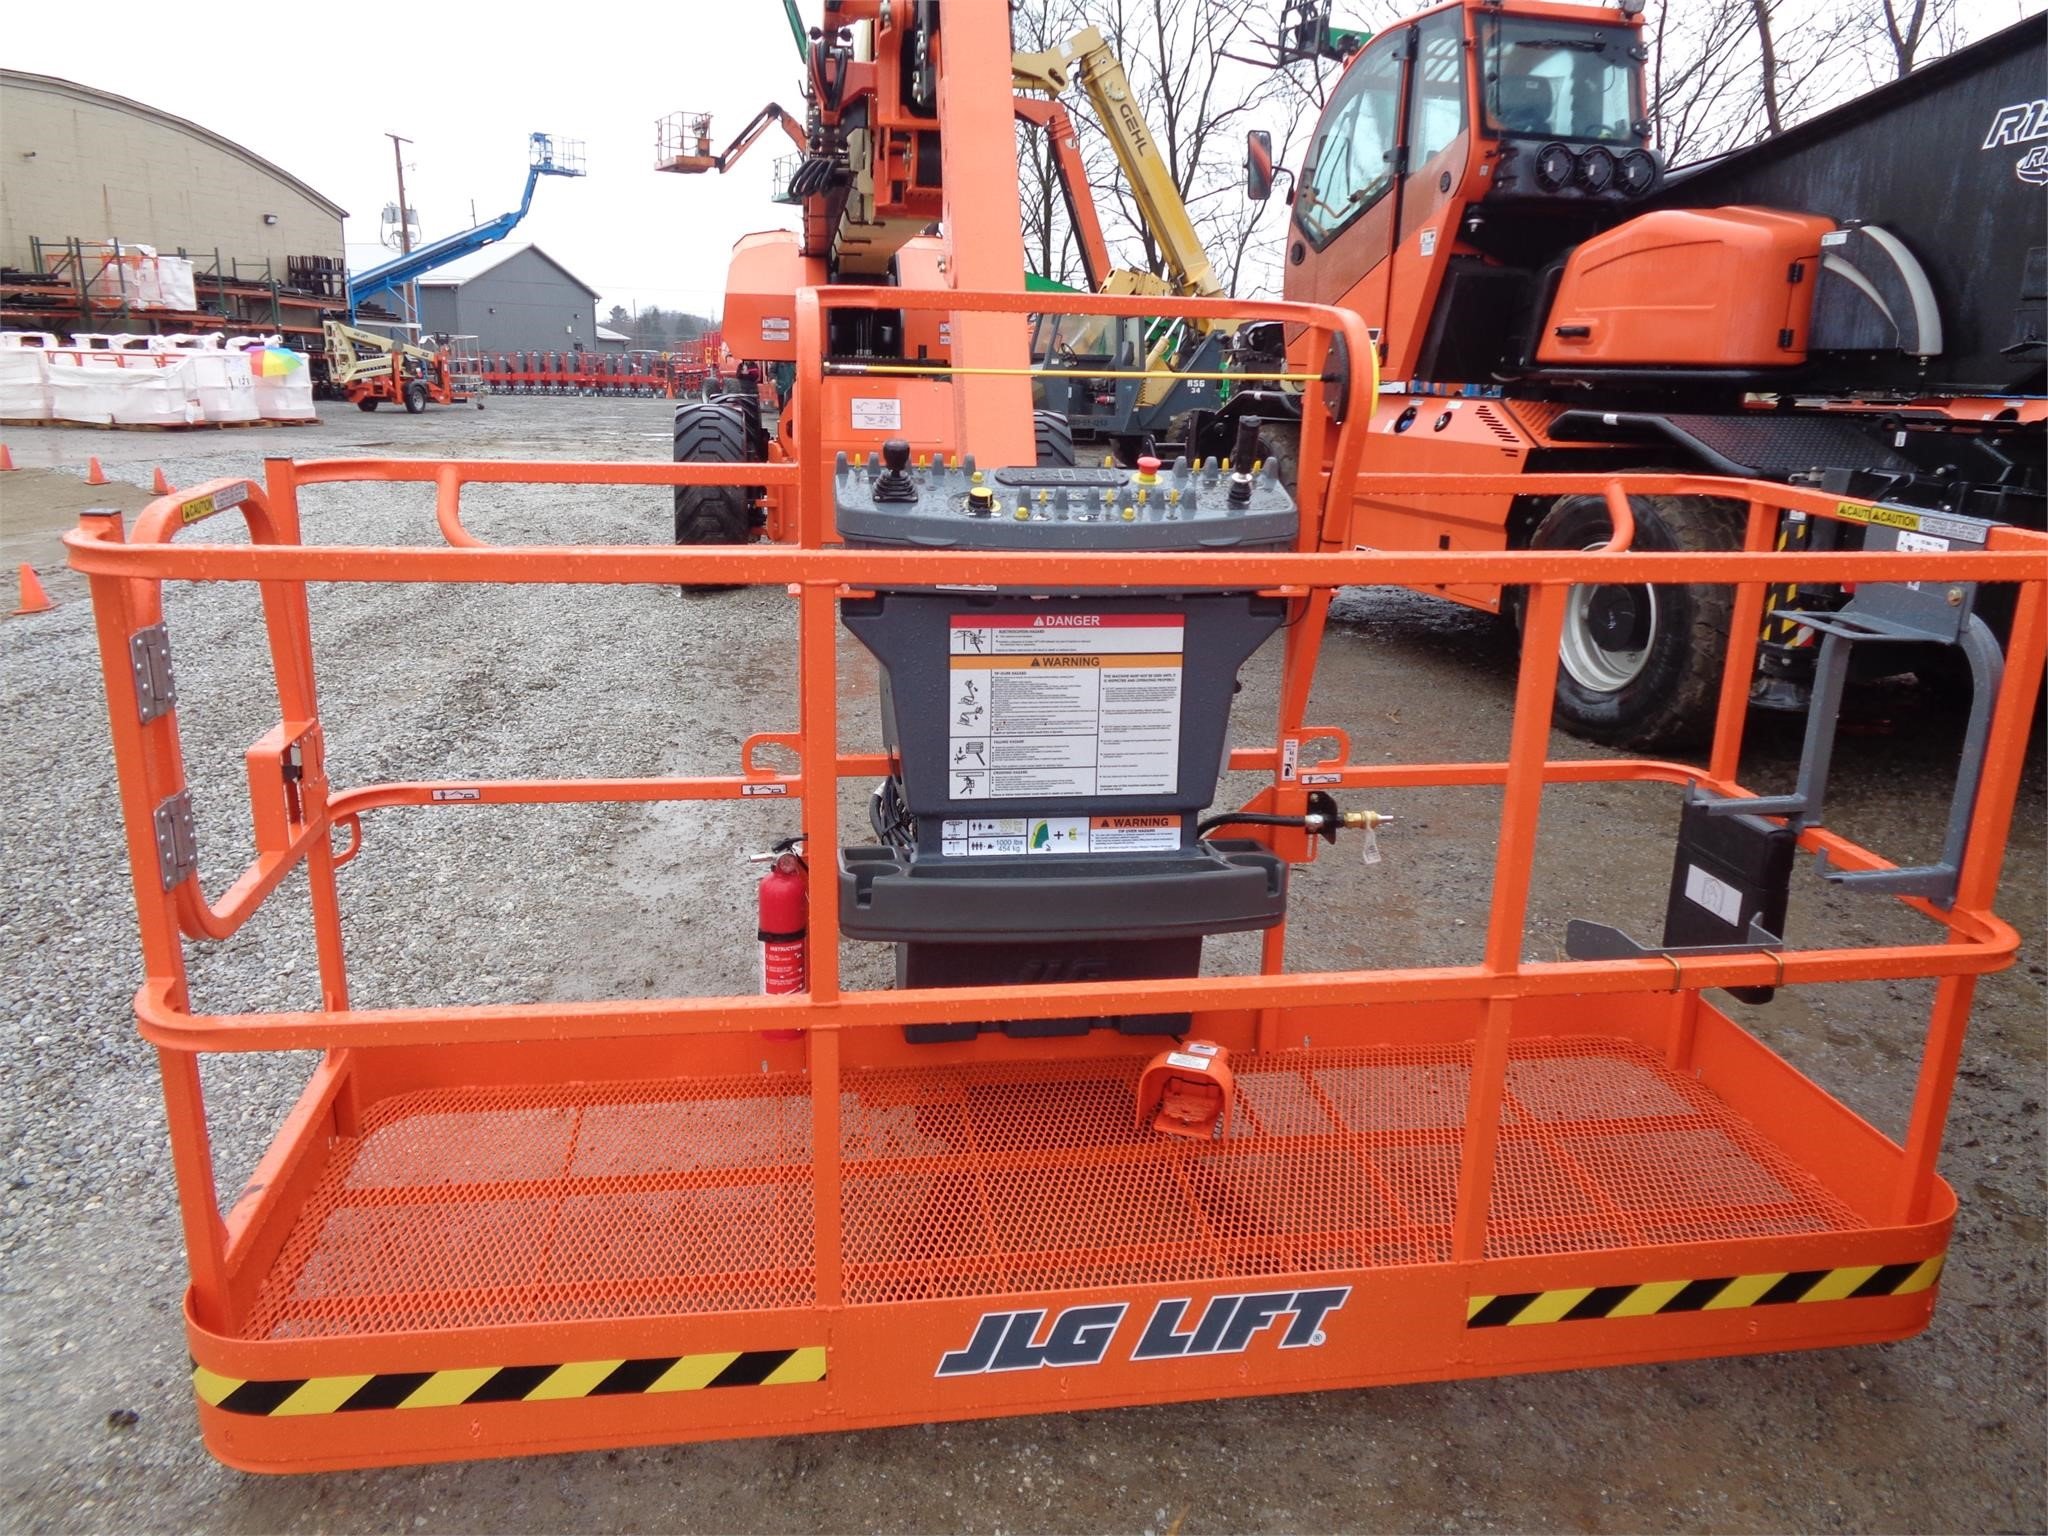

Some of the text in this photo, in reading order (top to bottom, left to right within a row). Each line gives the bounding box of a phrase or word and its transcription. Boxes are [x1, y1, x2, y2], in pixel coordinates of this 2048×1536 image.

[1120, 103, 1147, 157] GEHL
[1846, 505, 1871, 521] CAUTI
[1881, 509, 1917, 528] CAUTION
[1046, 616, 1100, 627] DANGER
[1043, 657, 1100, 667] WARNING
[1114, 817, 1169, 828] WARNING
[935, 1286, 1353, 1377] JLG LIFT
